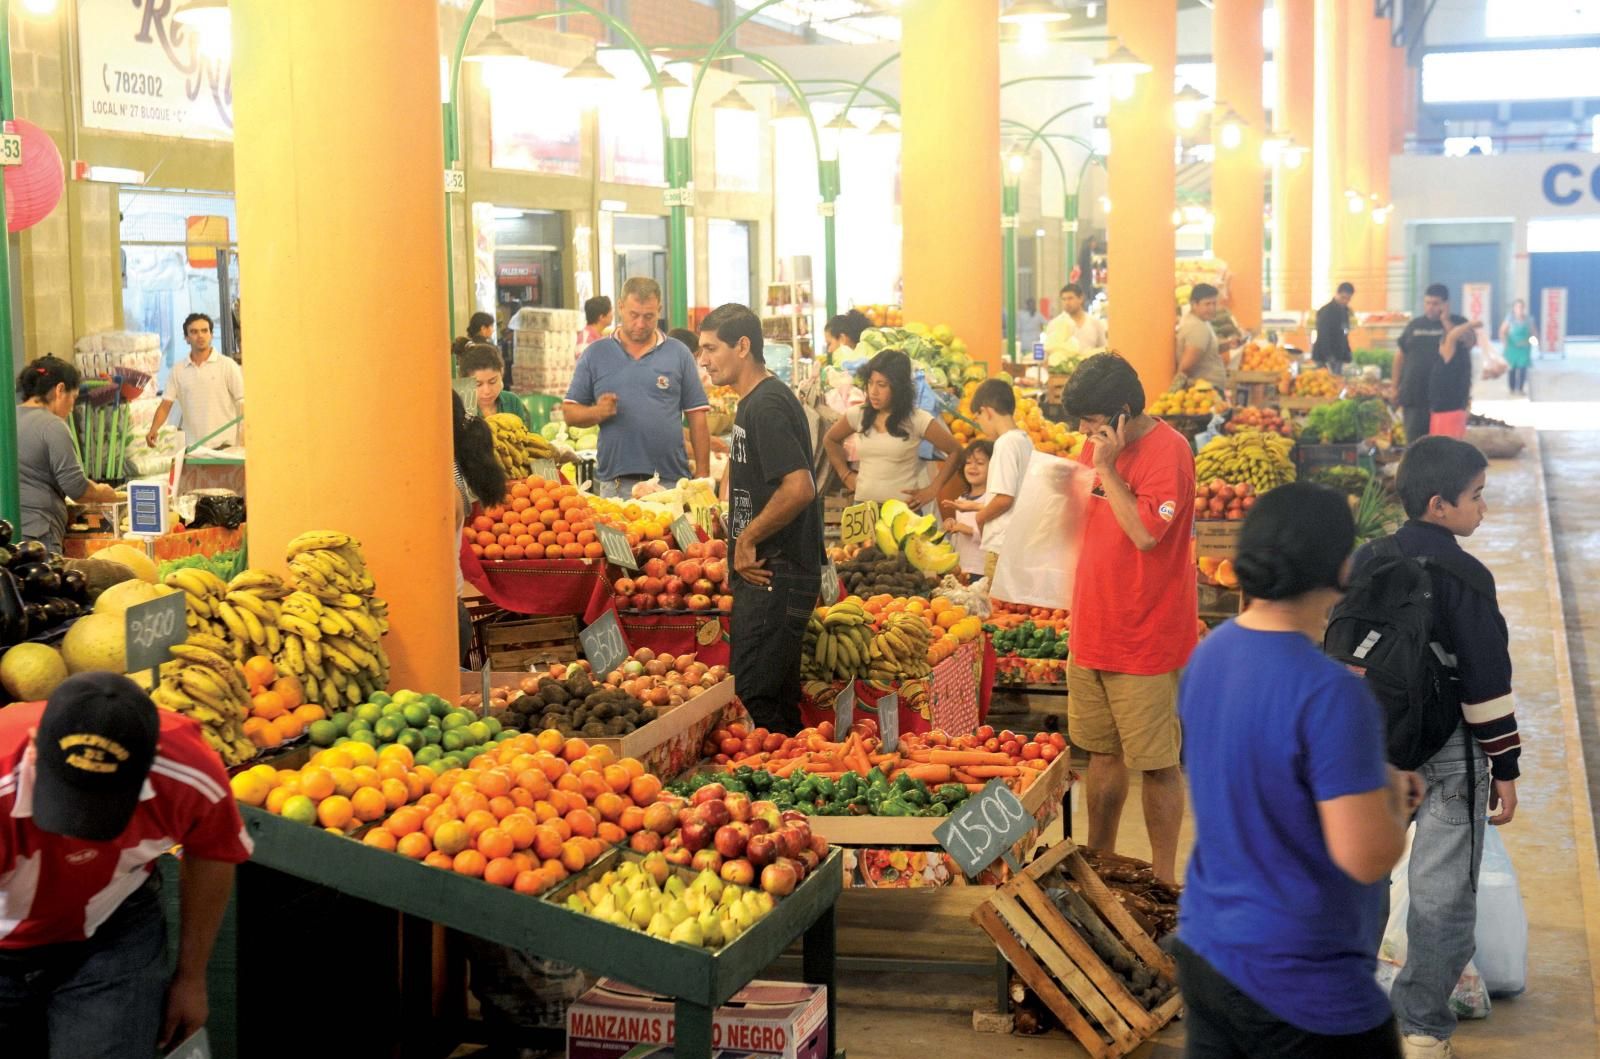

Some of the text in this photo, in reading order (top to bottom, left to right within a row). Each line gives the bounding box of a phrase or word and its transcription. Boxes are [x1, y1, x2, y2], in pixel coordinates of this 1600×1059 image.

[114, 70, 163, 98] 782302
[92, 100, 118, 116] LOCAL
[130, 105, 139, 118] 27
[140, 106, 170, 121] BLOQUE
[1542, 163, 1600, 206] C
[571, 1012, 661, 1044] MANZANAS
[727, 1023, 785, 1051] NEGRO
